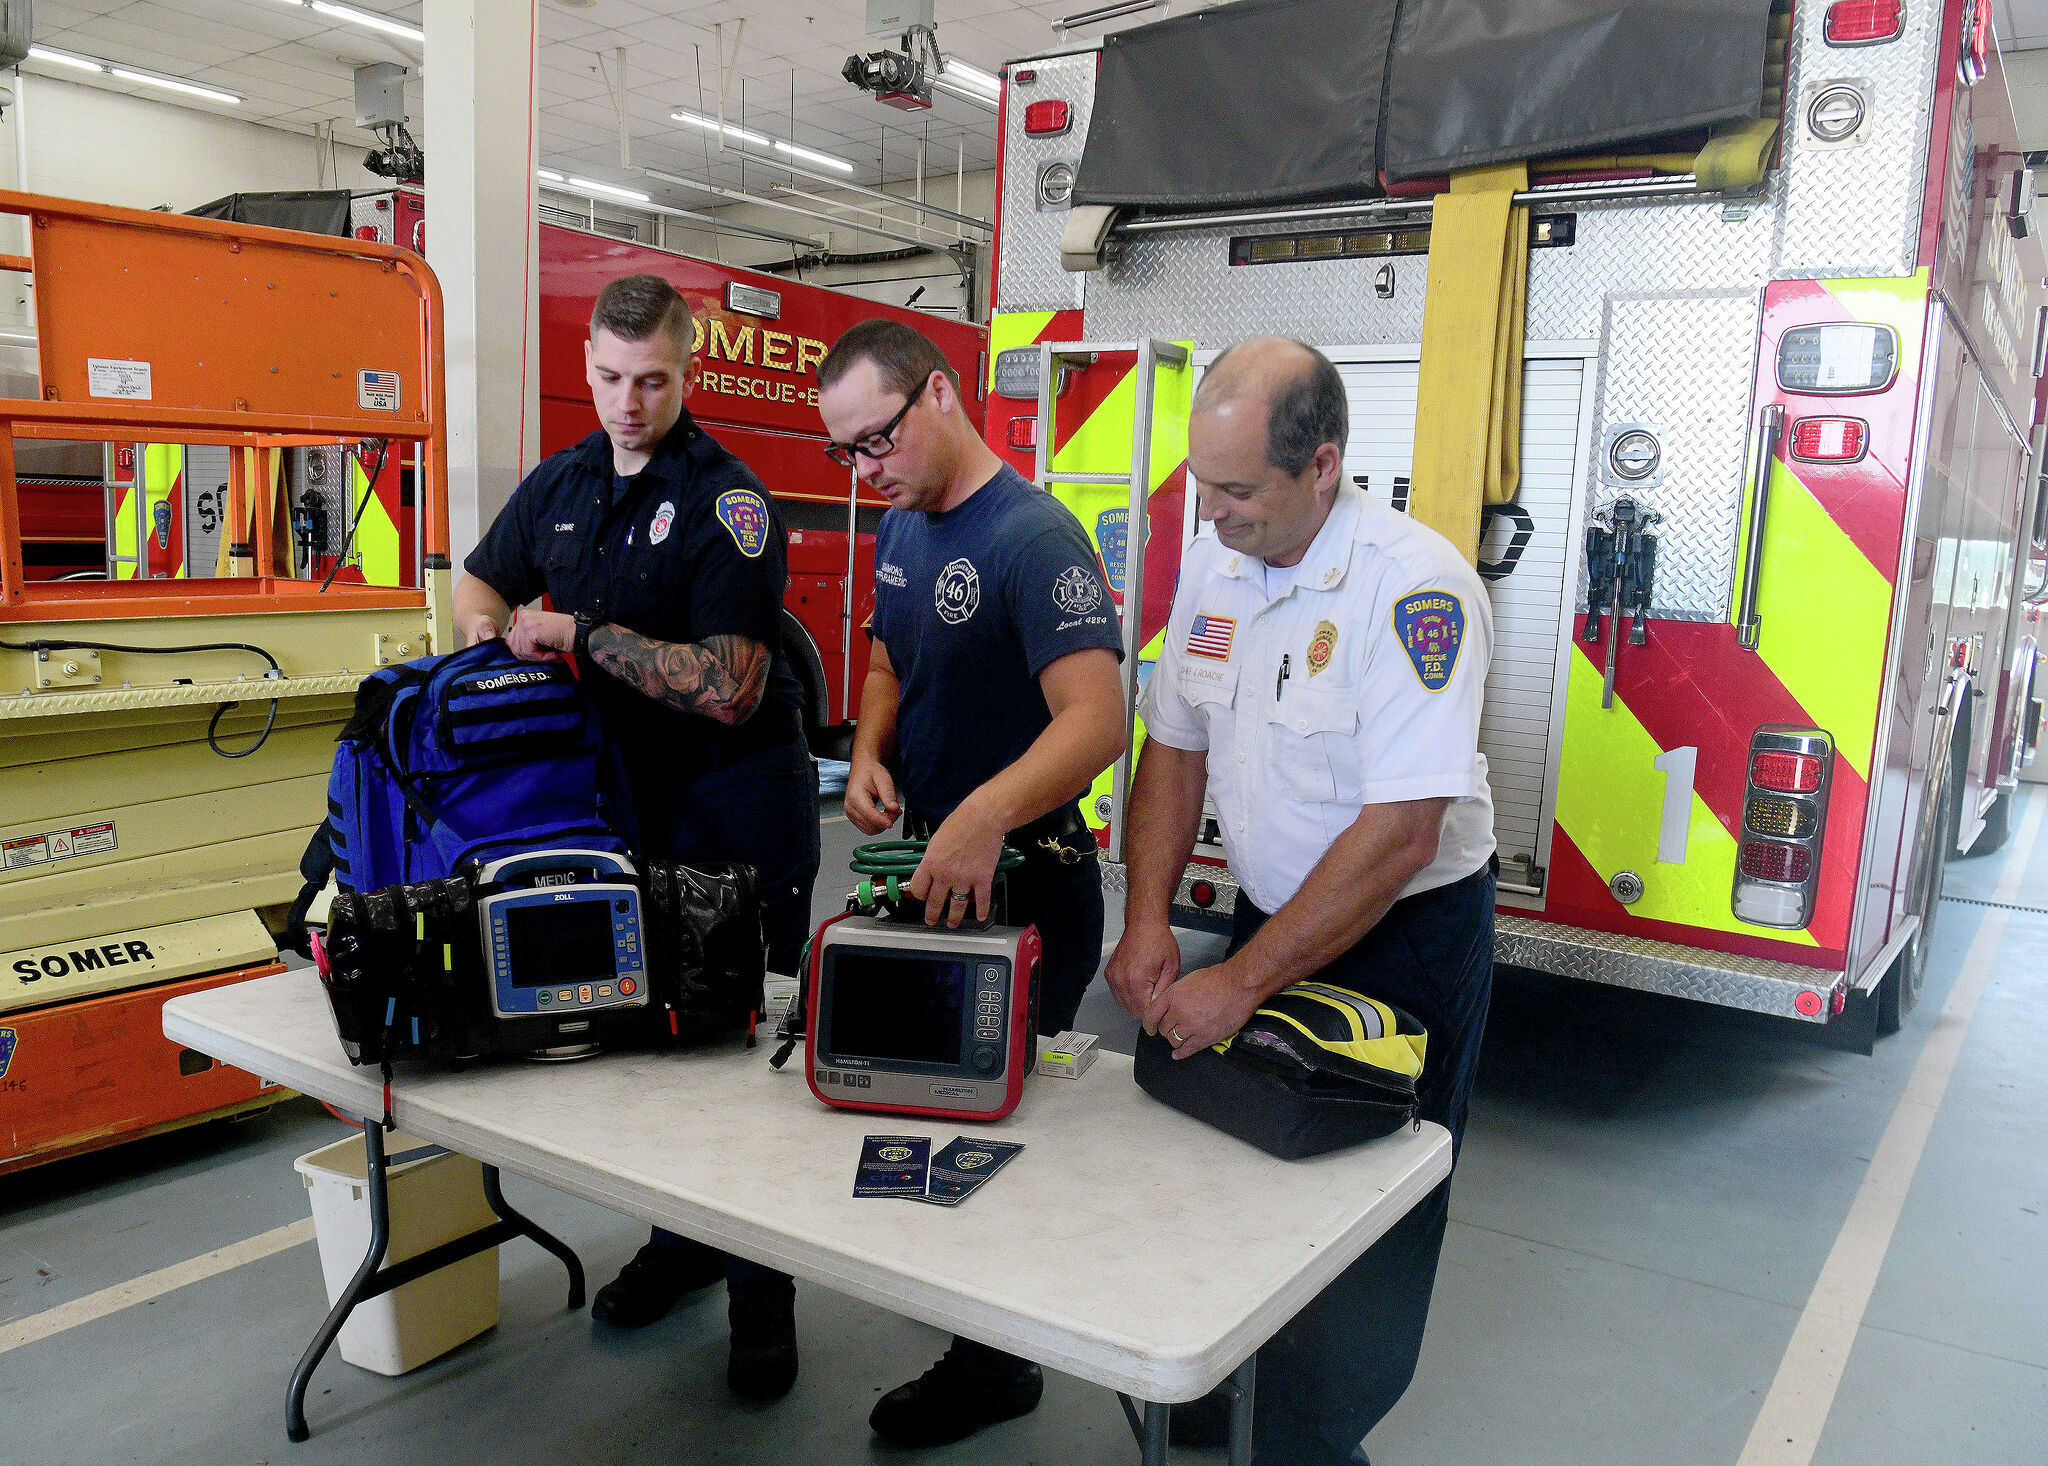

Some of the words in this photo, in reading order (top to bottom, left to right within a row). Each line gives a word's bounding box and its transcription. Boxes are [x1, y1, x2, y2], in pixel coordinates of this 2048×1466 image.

[702, 371, 796, 404] RESCUE
[725, 495, 761, 508] SOMERS
[946, 580, 965, 601] 46
[1405, 598, 1454, 615] SOMERS
[1056, 618, 1083, 631] Local
[1427, 628, 1440, 639] 46
[1421, 653, 1448, 662] RESCUE
[1424, 661, 1444, 673] F.D.
[476, 672, 529, 690] SOMERS
[529, 671, 551, 681] F.D.
[1654, 745, 1698, 864] 1
[534, 871, 577, 889] MEDIC
[12, 940, 155, 982] SOMER
